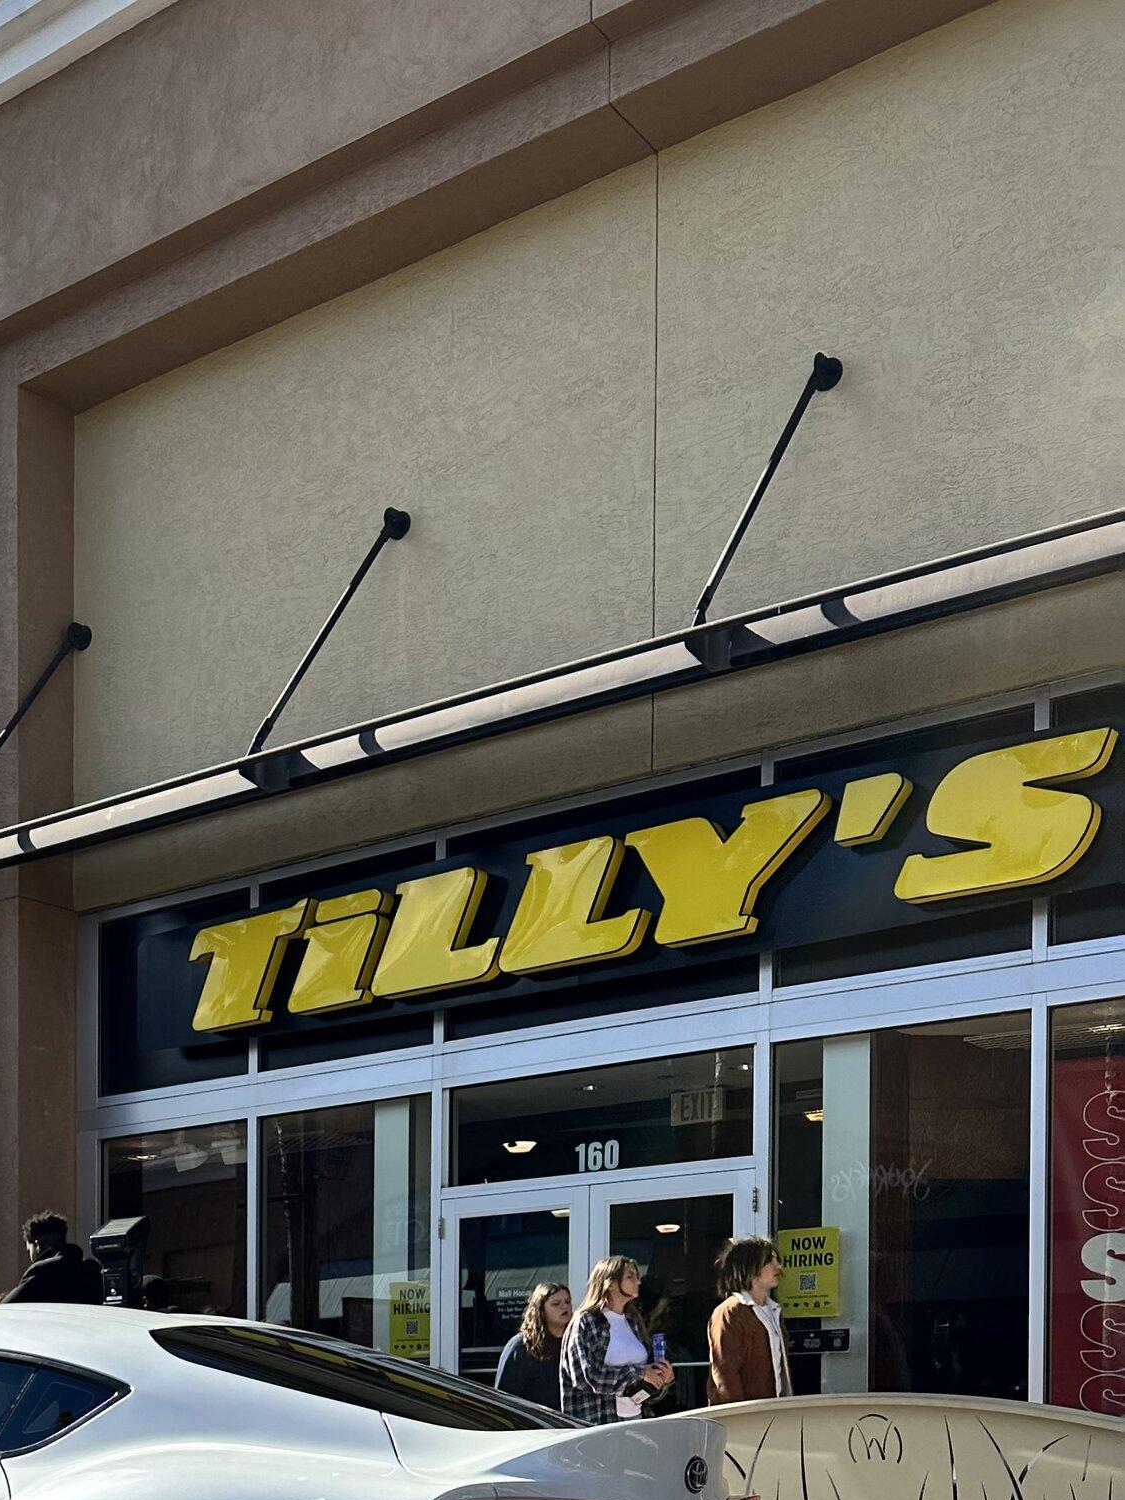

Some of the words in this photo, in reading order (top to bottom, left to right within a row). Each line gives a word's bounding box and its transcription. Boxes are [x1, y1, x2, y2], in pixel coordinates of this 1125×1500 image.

[680, 1090, 718, 1122] EXIT
[575, 1139, 620, 1172] 160
[791, 1236, 826, 1251] NOW
[783, 1252, 834, 1268] HIRING
[400, 1288, 426, 1301] NOW
